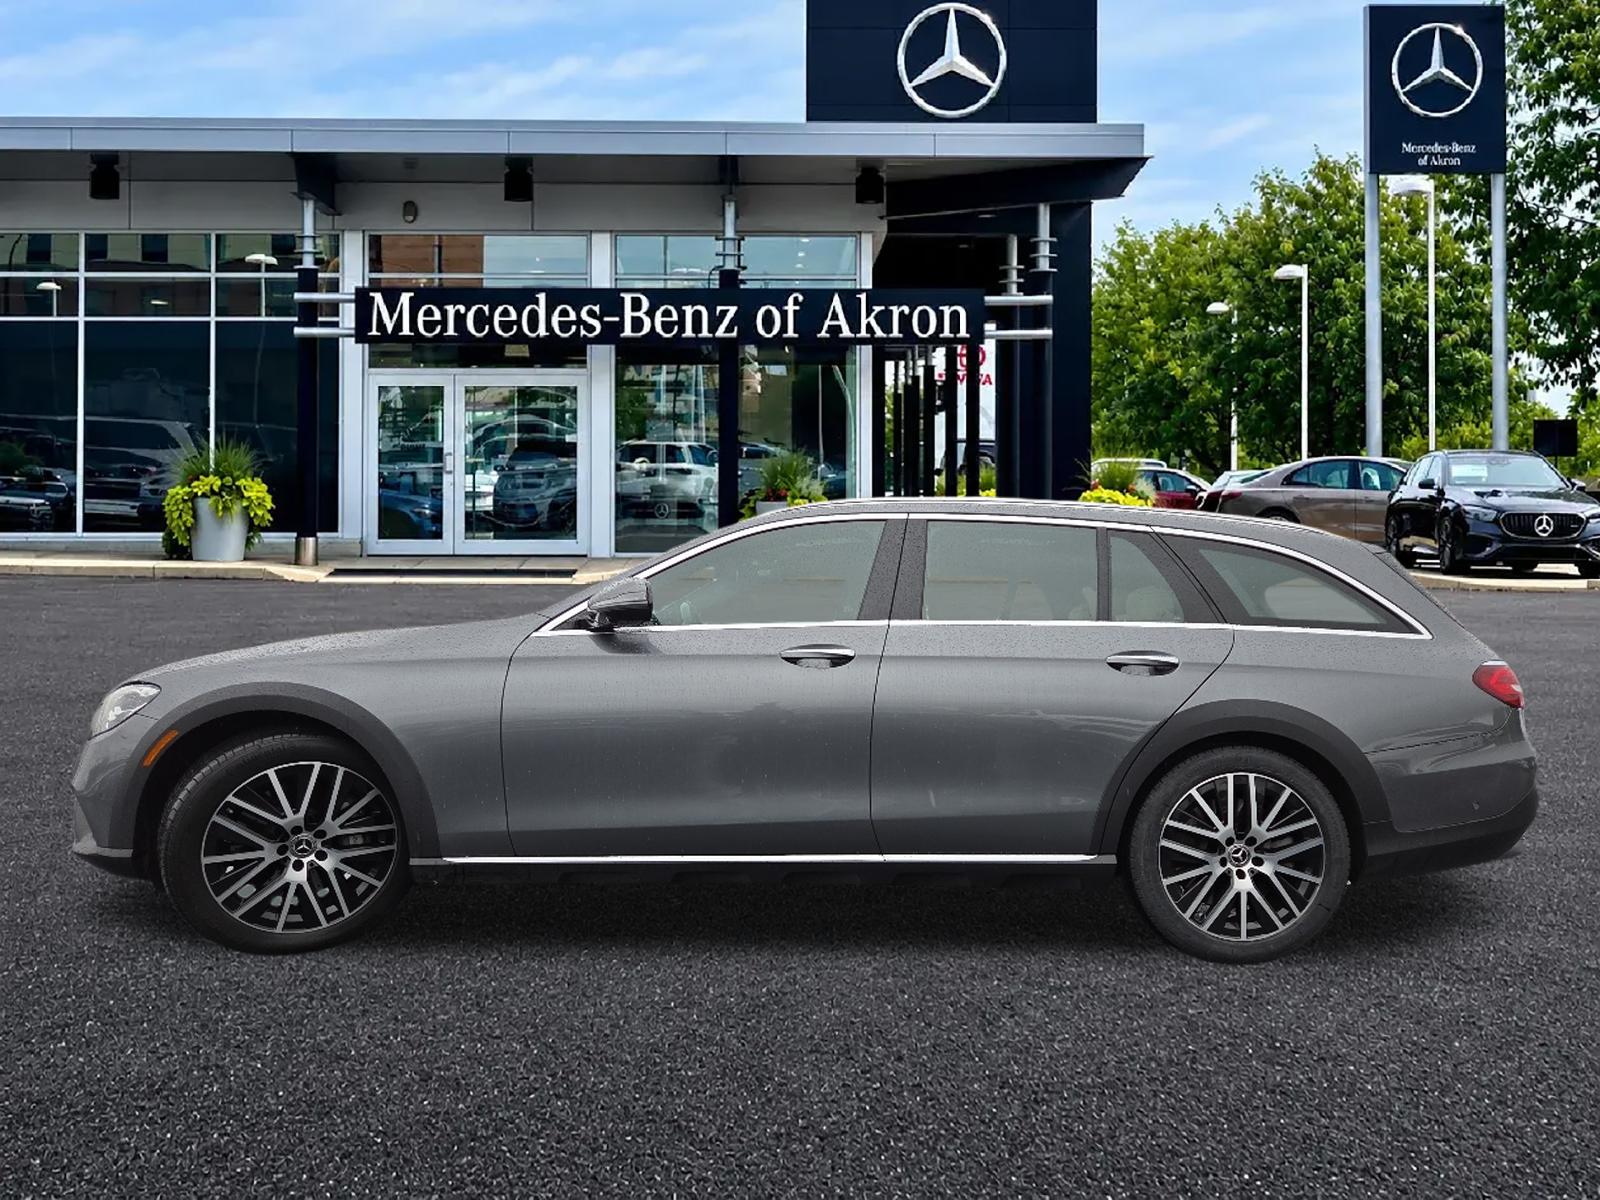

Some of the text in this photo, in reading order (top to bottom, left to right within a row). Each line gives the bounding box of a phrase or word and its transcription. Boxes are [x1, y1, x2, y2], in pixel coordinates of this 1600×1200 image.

[1401, 141, 1476, 153] Mercedes-Benz
[1418, 155, 1461, 165] of Akron
[367, 291, 970, 338] Mercedes-Benz of Akron
